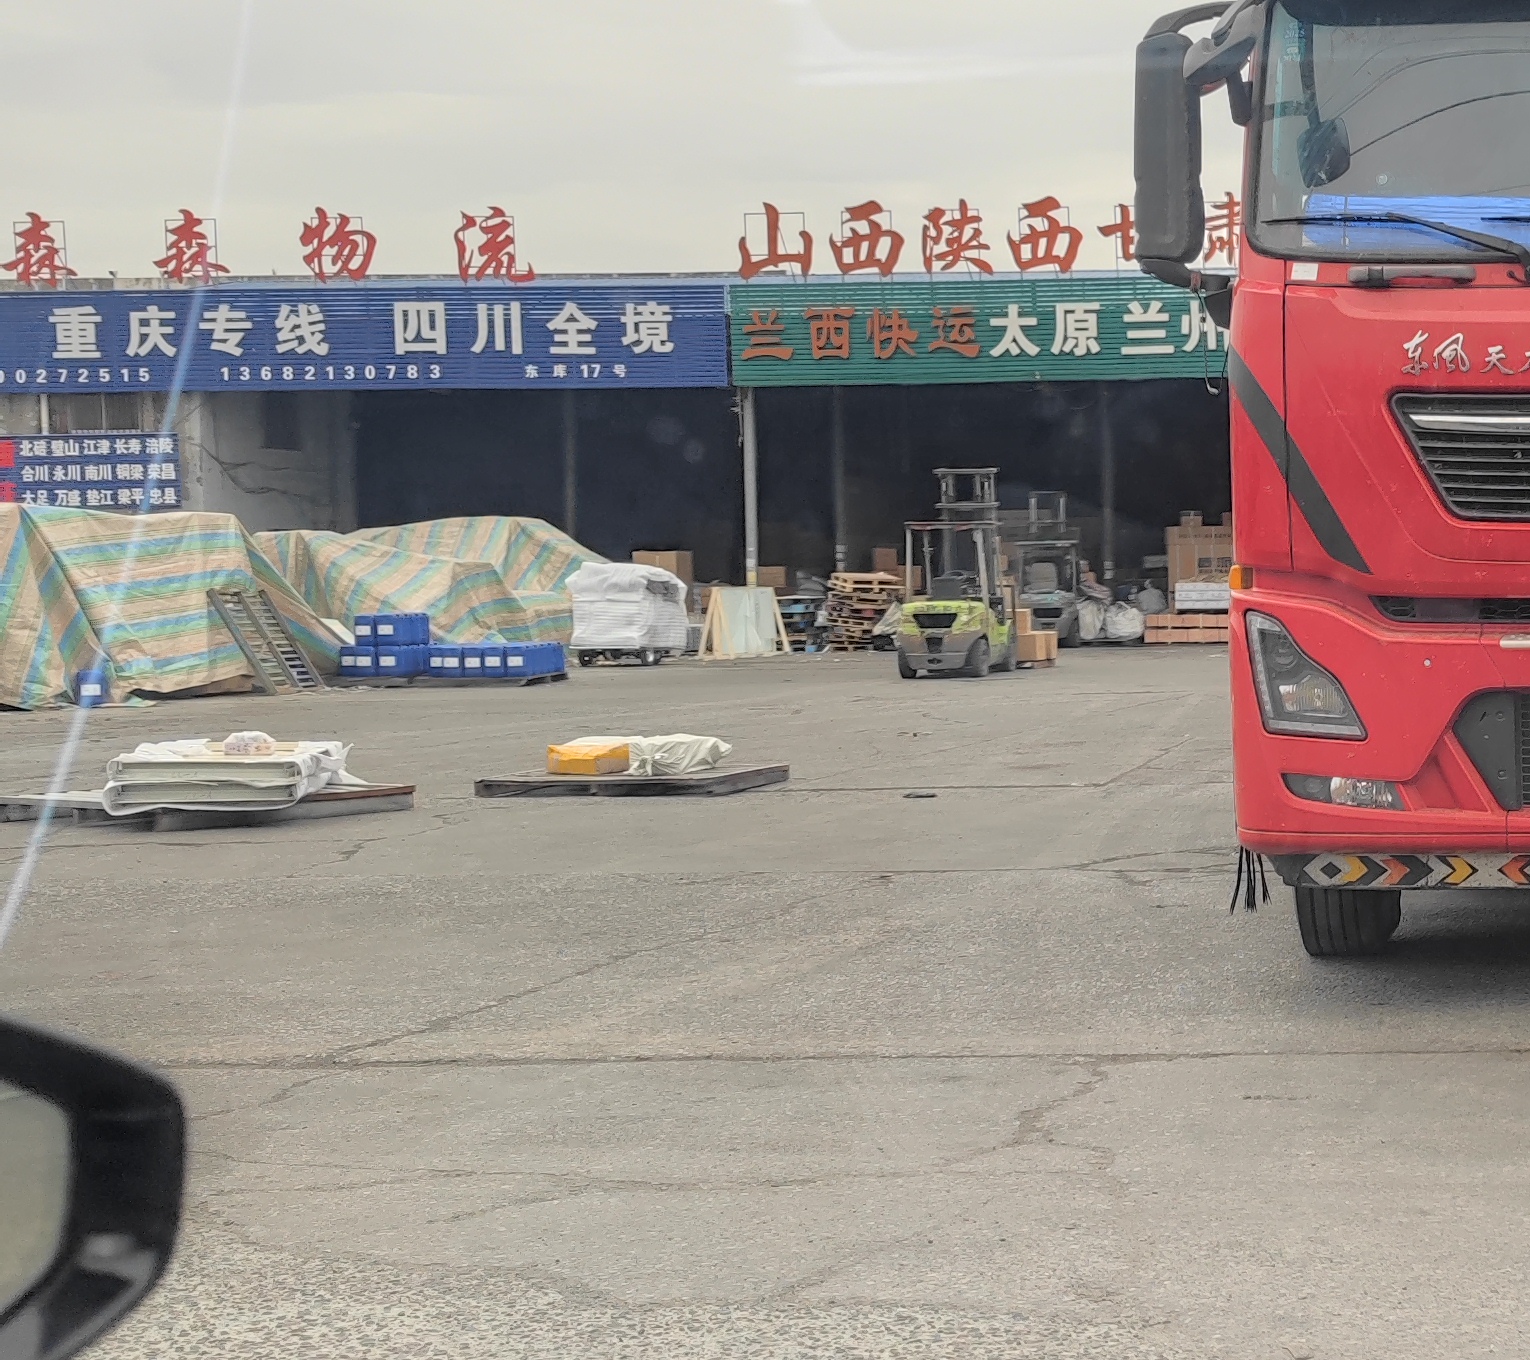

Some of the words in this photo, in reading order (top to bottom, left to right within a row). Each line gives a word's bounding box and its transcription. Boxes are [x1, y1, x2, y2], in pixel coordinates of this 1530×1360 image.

[0, 206, 536, 285] 森森物流
[48, 302, 330, 360] 重庆专线
[392, 300, 675, 356] 四川全境
[740, 305, 981, 361] 兰西快运
[989, 300, 1101, 358] 太原
[219, 364, 442, 381] 13682130783
[19, 439, 48, 457] 北碚
[82, 438, 111, 456] 江津
[114, 438, 143, 455] 长寿
[145, 436, 175, 454] 涪陵
[20, 464, 49, 482] 合川
[52, 464, 81, 481] 永川
[84, 463, 113, 481] 南川
[115, 463, 144, 481] 铜梁
[147, 462, 176, 480] 荣昌
[21, 489, 49, 506] 大足
[54, 489, 82, 506] 万盛
[86, 489, 114, 506] 垫江
[117, 487, 145, 505] 梁平
[149, 487, 178, 505] 忠县
